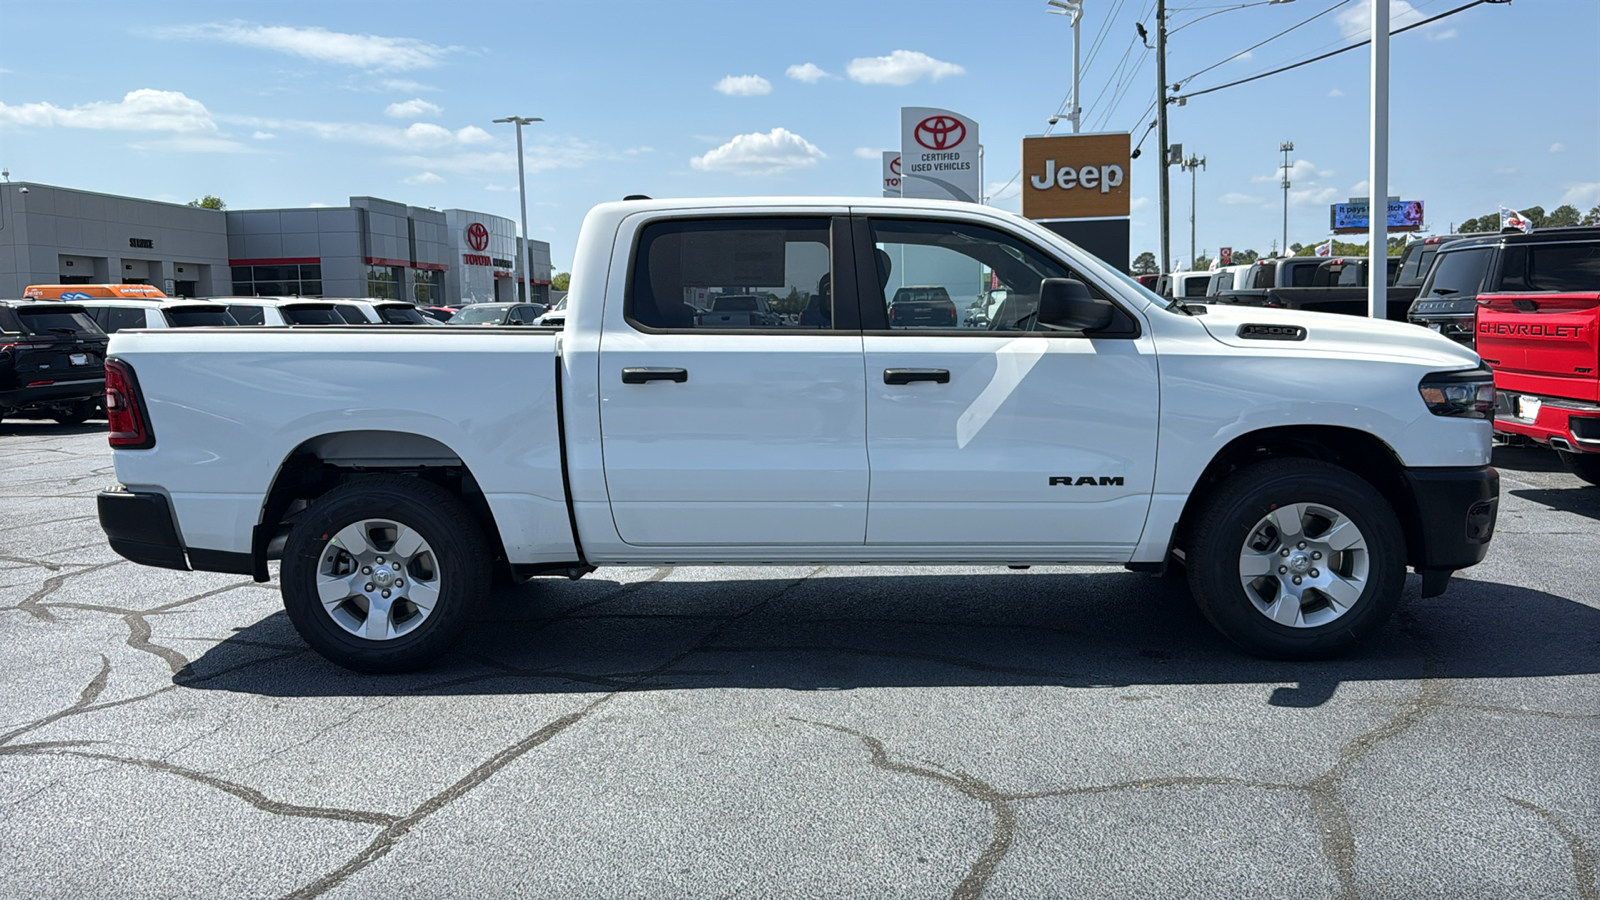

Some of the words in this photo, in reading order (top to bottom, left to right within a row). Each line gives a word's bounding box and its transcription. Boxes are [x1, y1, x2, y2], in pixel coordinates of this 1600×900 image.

[921, 152, 960, 162] CERTIFIED
[911, 163, 932, 172] USED
[934, 162, 971, 171] VEHICLES
[1030, 159, 1124, 194] Jeep
[1346, 205, 1366, 214] pays
[462, 253, 492, 267] TOYOTA
[1248, 326, 1296, 334] 1500
[1479, 322, 1584, 338] CHEVROLET
[1049, 476, 1124, 486] RAM
